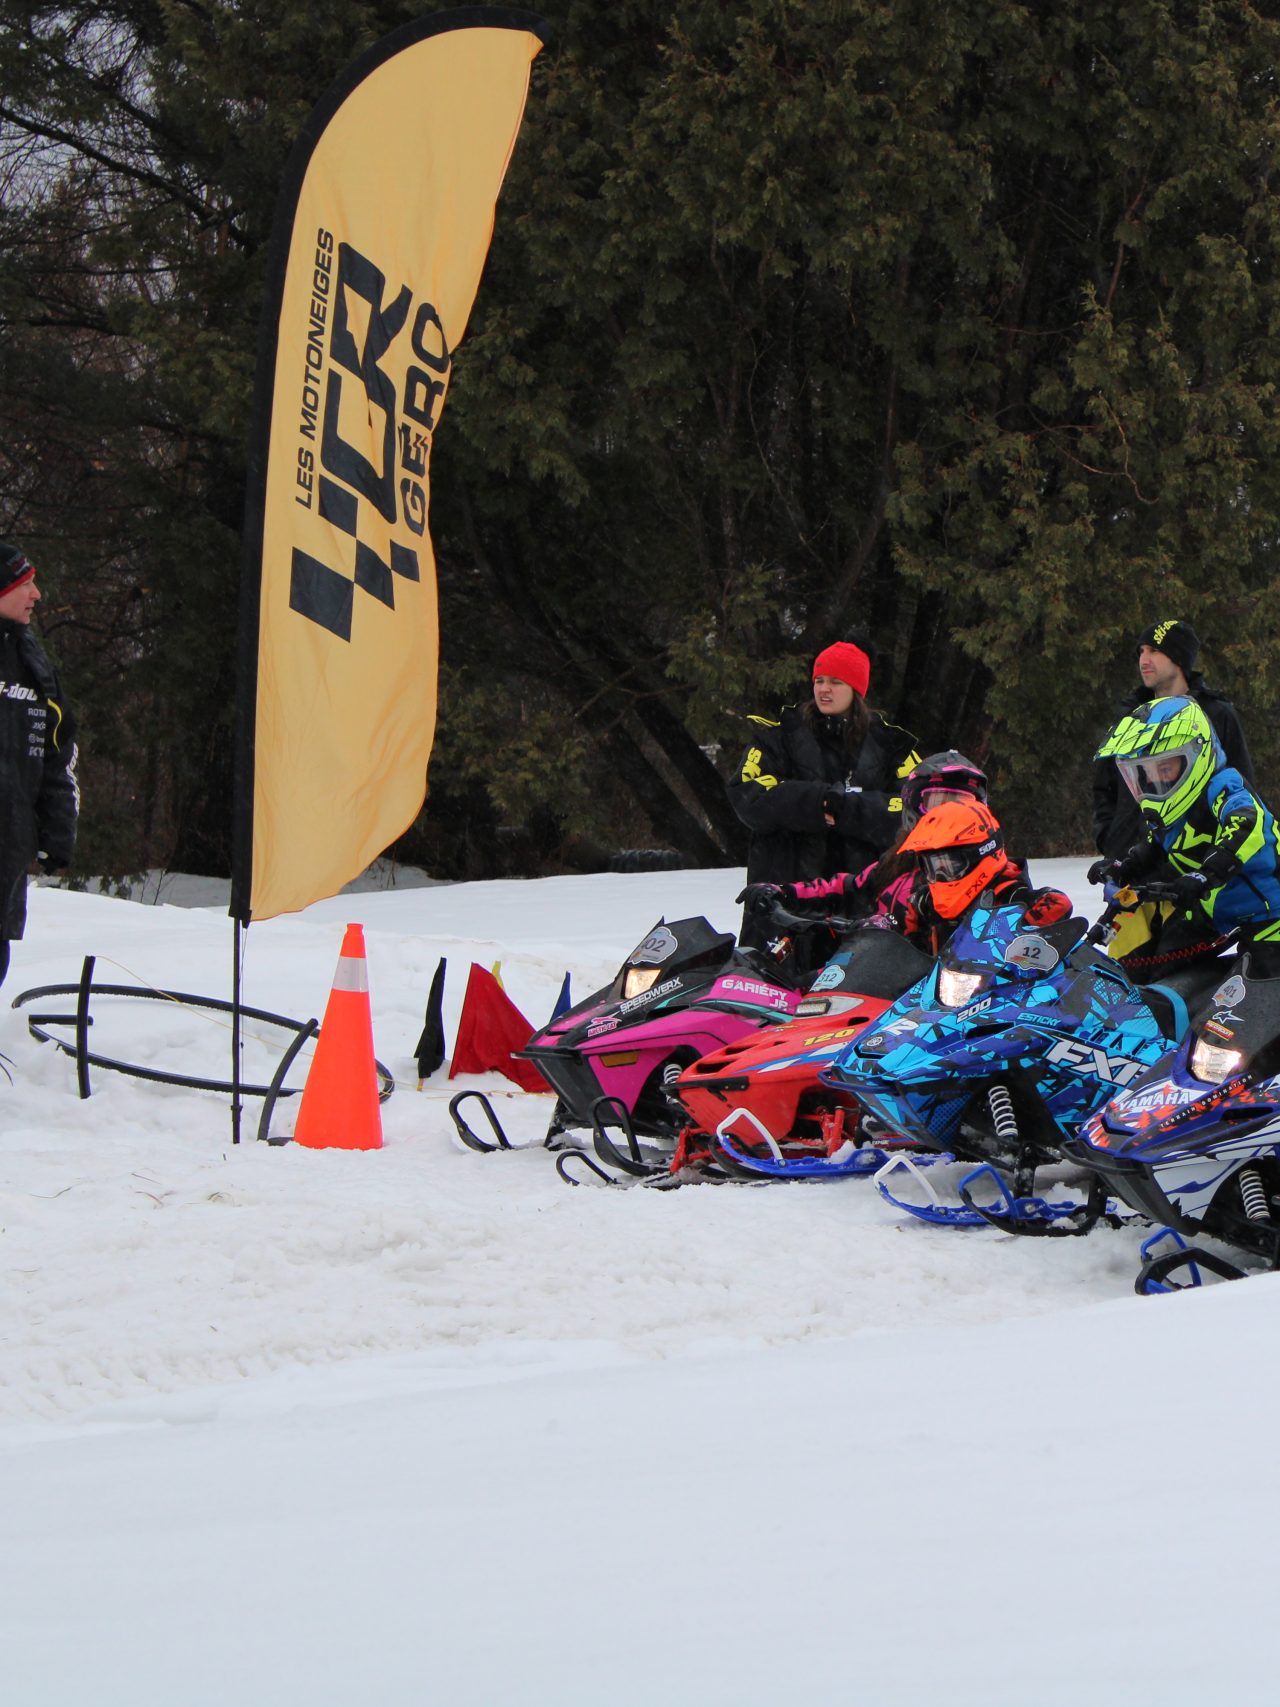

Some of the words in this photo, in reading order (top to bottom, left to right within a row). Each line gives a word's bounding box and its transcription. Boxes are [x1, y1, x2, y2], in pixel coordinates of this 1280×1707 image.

[300, 227, 335, 439] MOTONEIGES
[295, 446, 318, 509] LES
[978, 840, 997, 856] 509
[965, 872, 988, 899] FXR
[1022, 946, 1042, 960] 12
[620, 976, 681, 1012] SPEEDWERX
[721, 979, 788, 1001] GARIÉPY
[955, 997, 993, 1024] 200
[1016, 1011, 1062, 1027] ESTICKY
[803, 1028, 855, 1047] 120
[1119, 1091, 1190, 1110] YAMAHA
[1159, 1106, 1196, 1128] TERRAIN
[1201, 1074, 1253, 1106] DOMINATION
